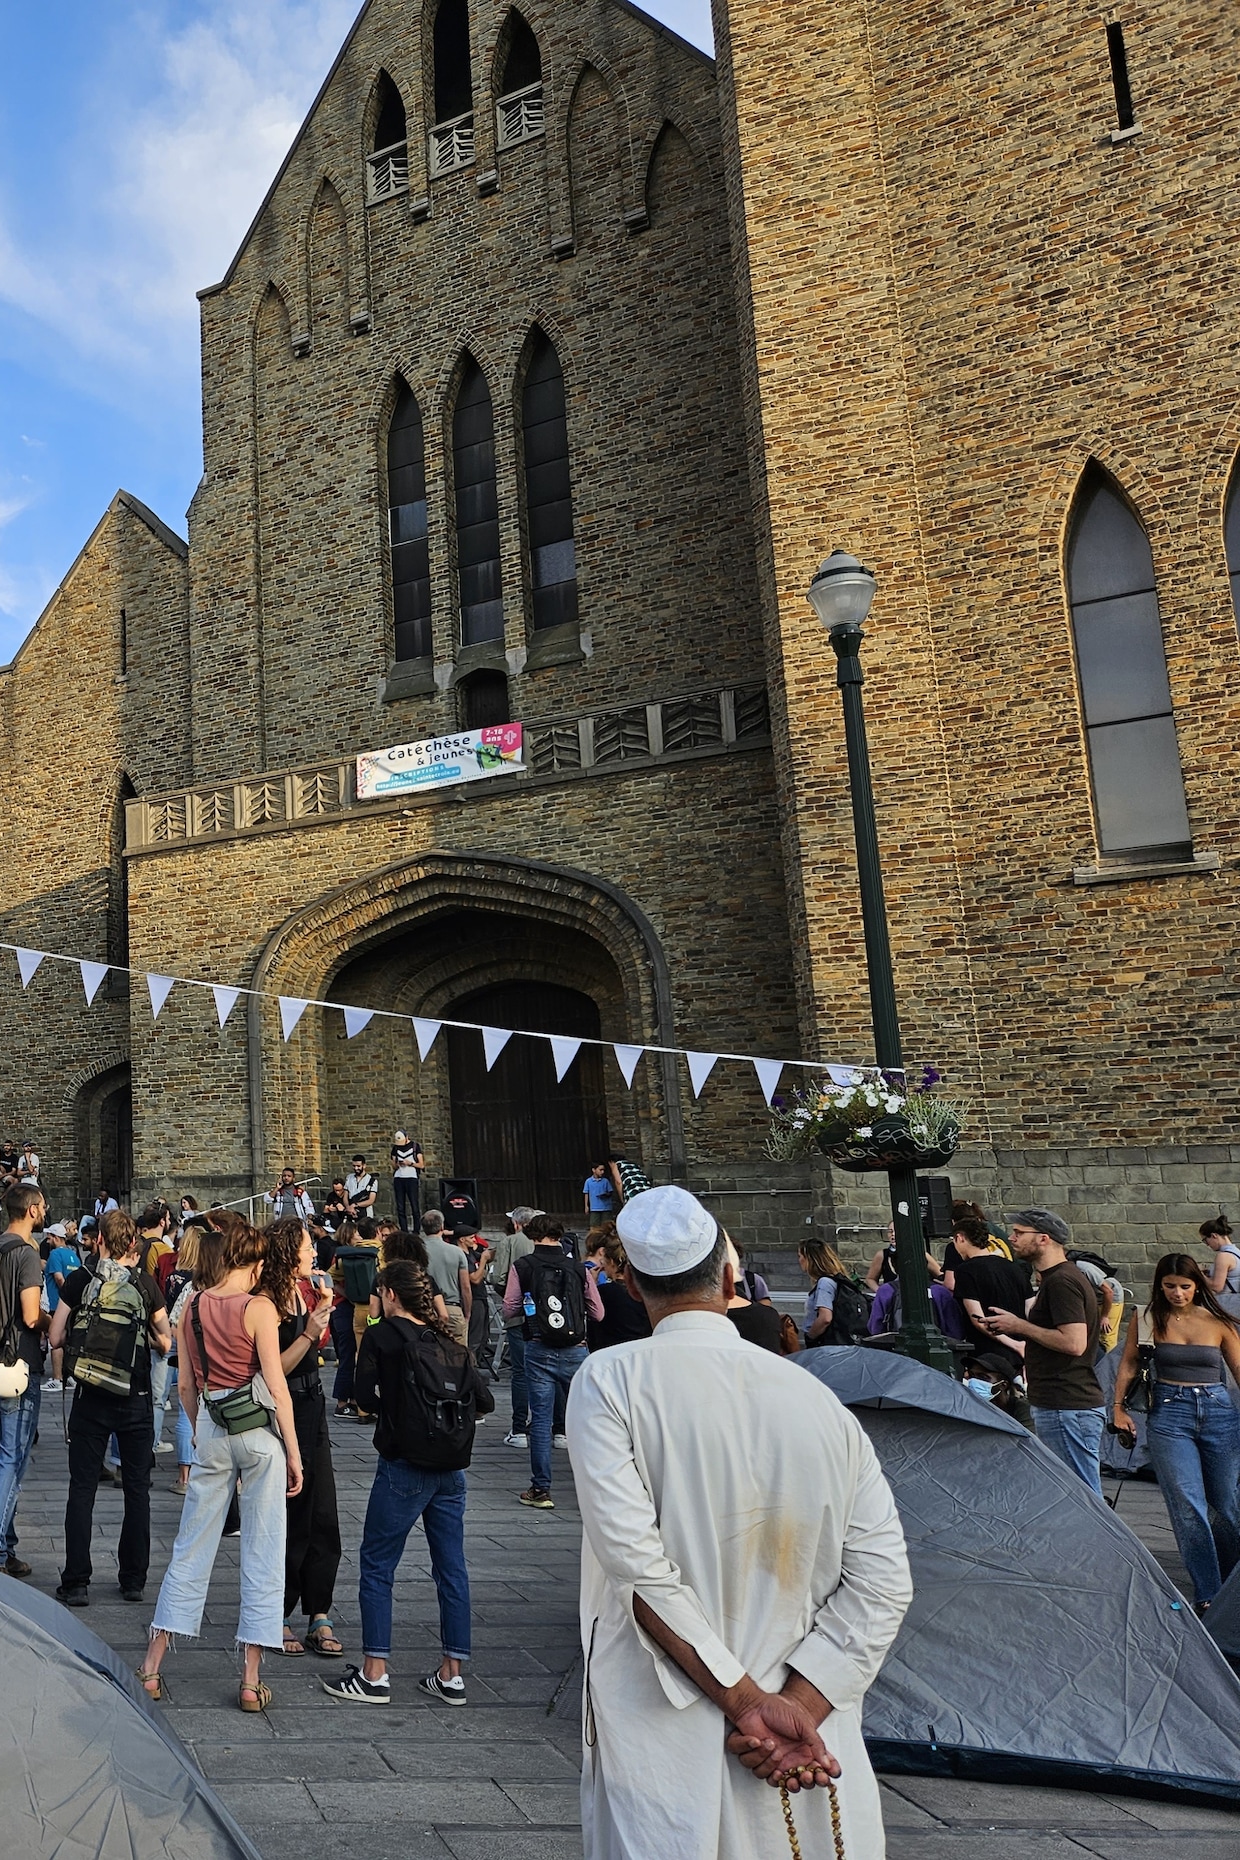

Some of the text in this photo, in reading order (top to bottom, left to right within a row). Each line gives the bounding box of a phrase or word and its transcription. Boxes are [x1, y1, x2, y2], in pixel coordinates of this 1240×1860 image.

[485, 728, 503, 736] 7-18
[387, 736, 471, 761] Catéchèse
[416, 747, 474, 766] & jeunes
[391, 765, 445, 781] INSCRIPTIONS
